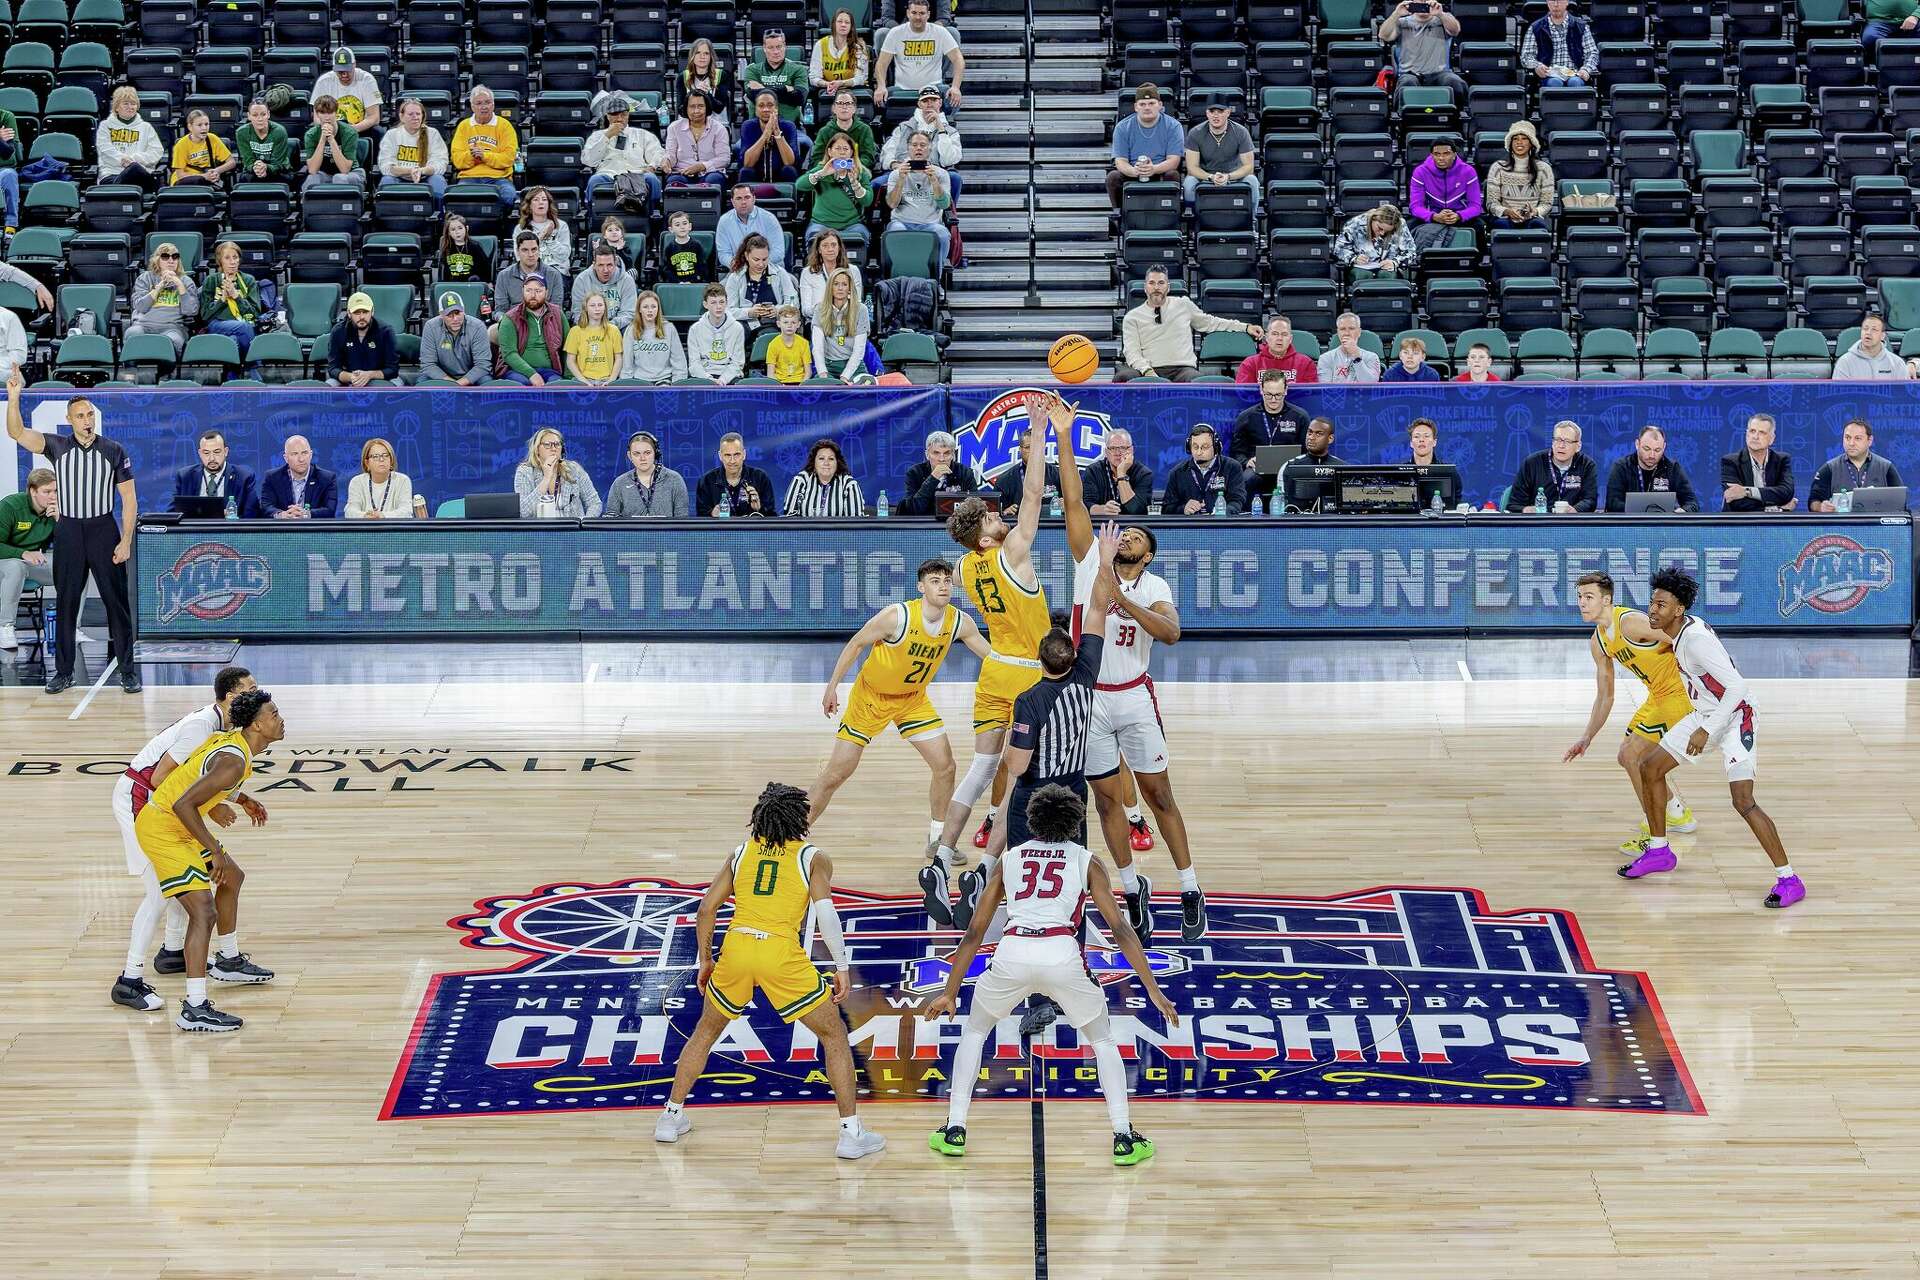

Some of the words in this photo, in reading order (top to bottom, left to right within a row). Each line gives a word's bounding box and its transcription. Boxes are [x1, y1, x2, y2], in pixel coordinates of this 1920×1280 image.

[905, 41, 935, 55] SIENA
[398, 146, 418, 161] SIEN
[633, 340, 669, 352] Saints
[991, 396, 1017, 415] METRO
[1422, 406, 1495, 418] BASKETBALL
[1648, 406, 1721, 418] BASKETBALL
[532, 411, 606, 423] BASKETBALL
[757, 411, 831, 423] BASKETBALL
[957, 417, 1105, 476] MAC
[161, 557, 268, 613] MAAC
[308, 552, 542, 613] METRO
[569, 551, 906, 613] ATLANTIC
[1782, 550, 1889, 606] MAAC
[976, 577, 1007, 614] 13
[1115, 625, 1136, 647] 33
[904, 660, 934, 684] 21
[290, 748, 454, 756] WHELAN
[8, 757, 635, 776] BORDWALK
[252, 777, 436, 792] ALL
[1020, 849, 1052, 859] WEEKS
[1052, 849, 1067, 859] JR.
[753, 859, 780, 896] 0
[1014, 860, 1067, 901] 35
[1193, 996, 1561, 1009] BASKETBALL
[1145, 1067, 1281, 1083] CITY
